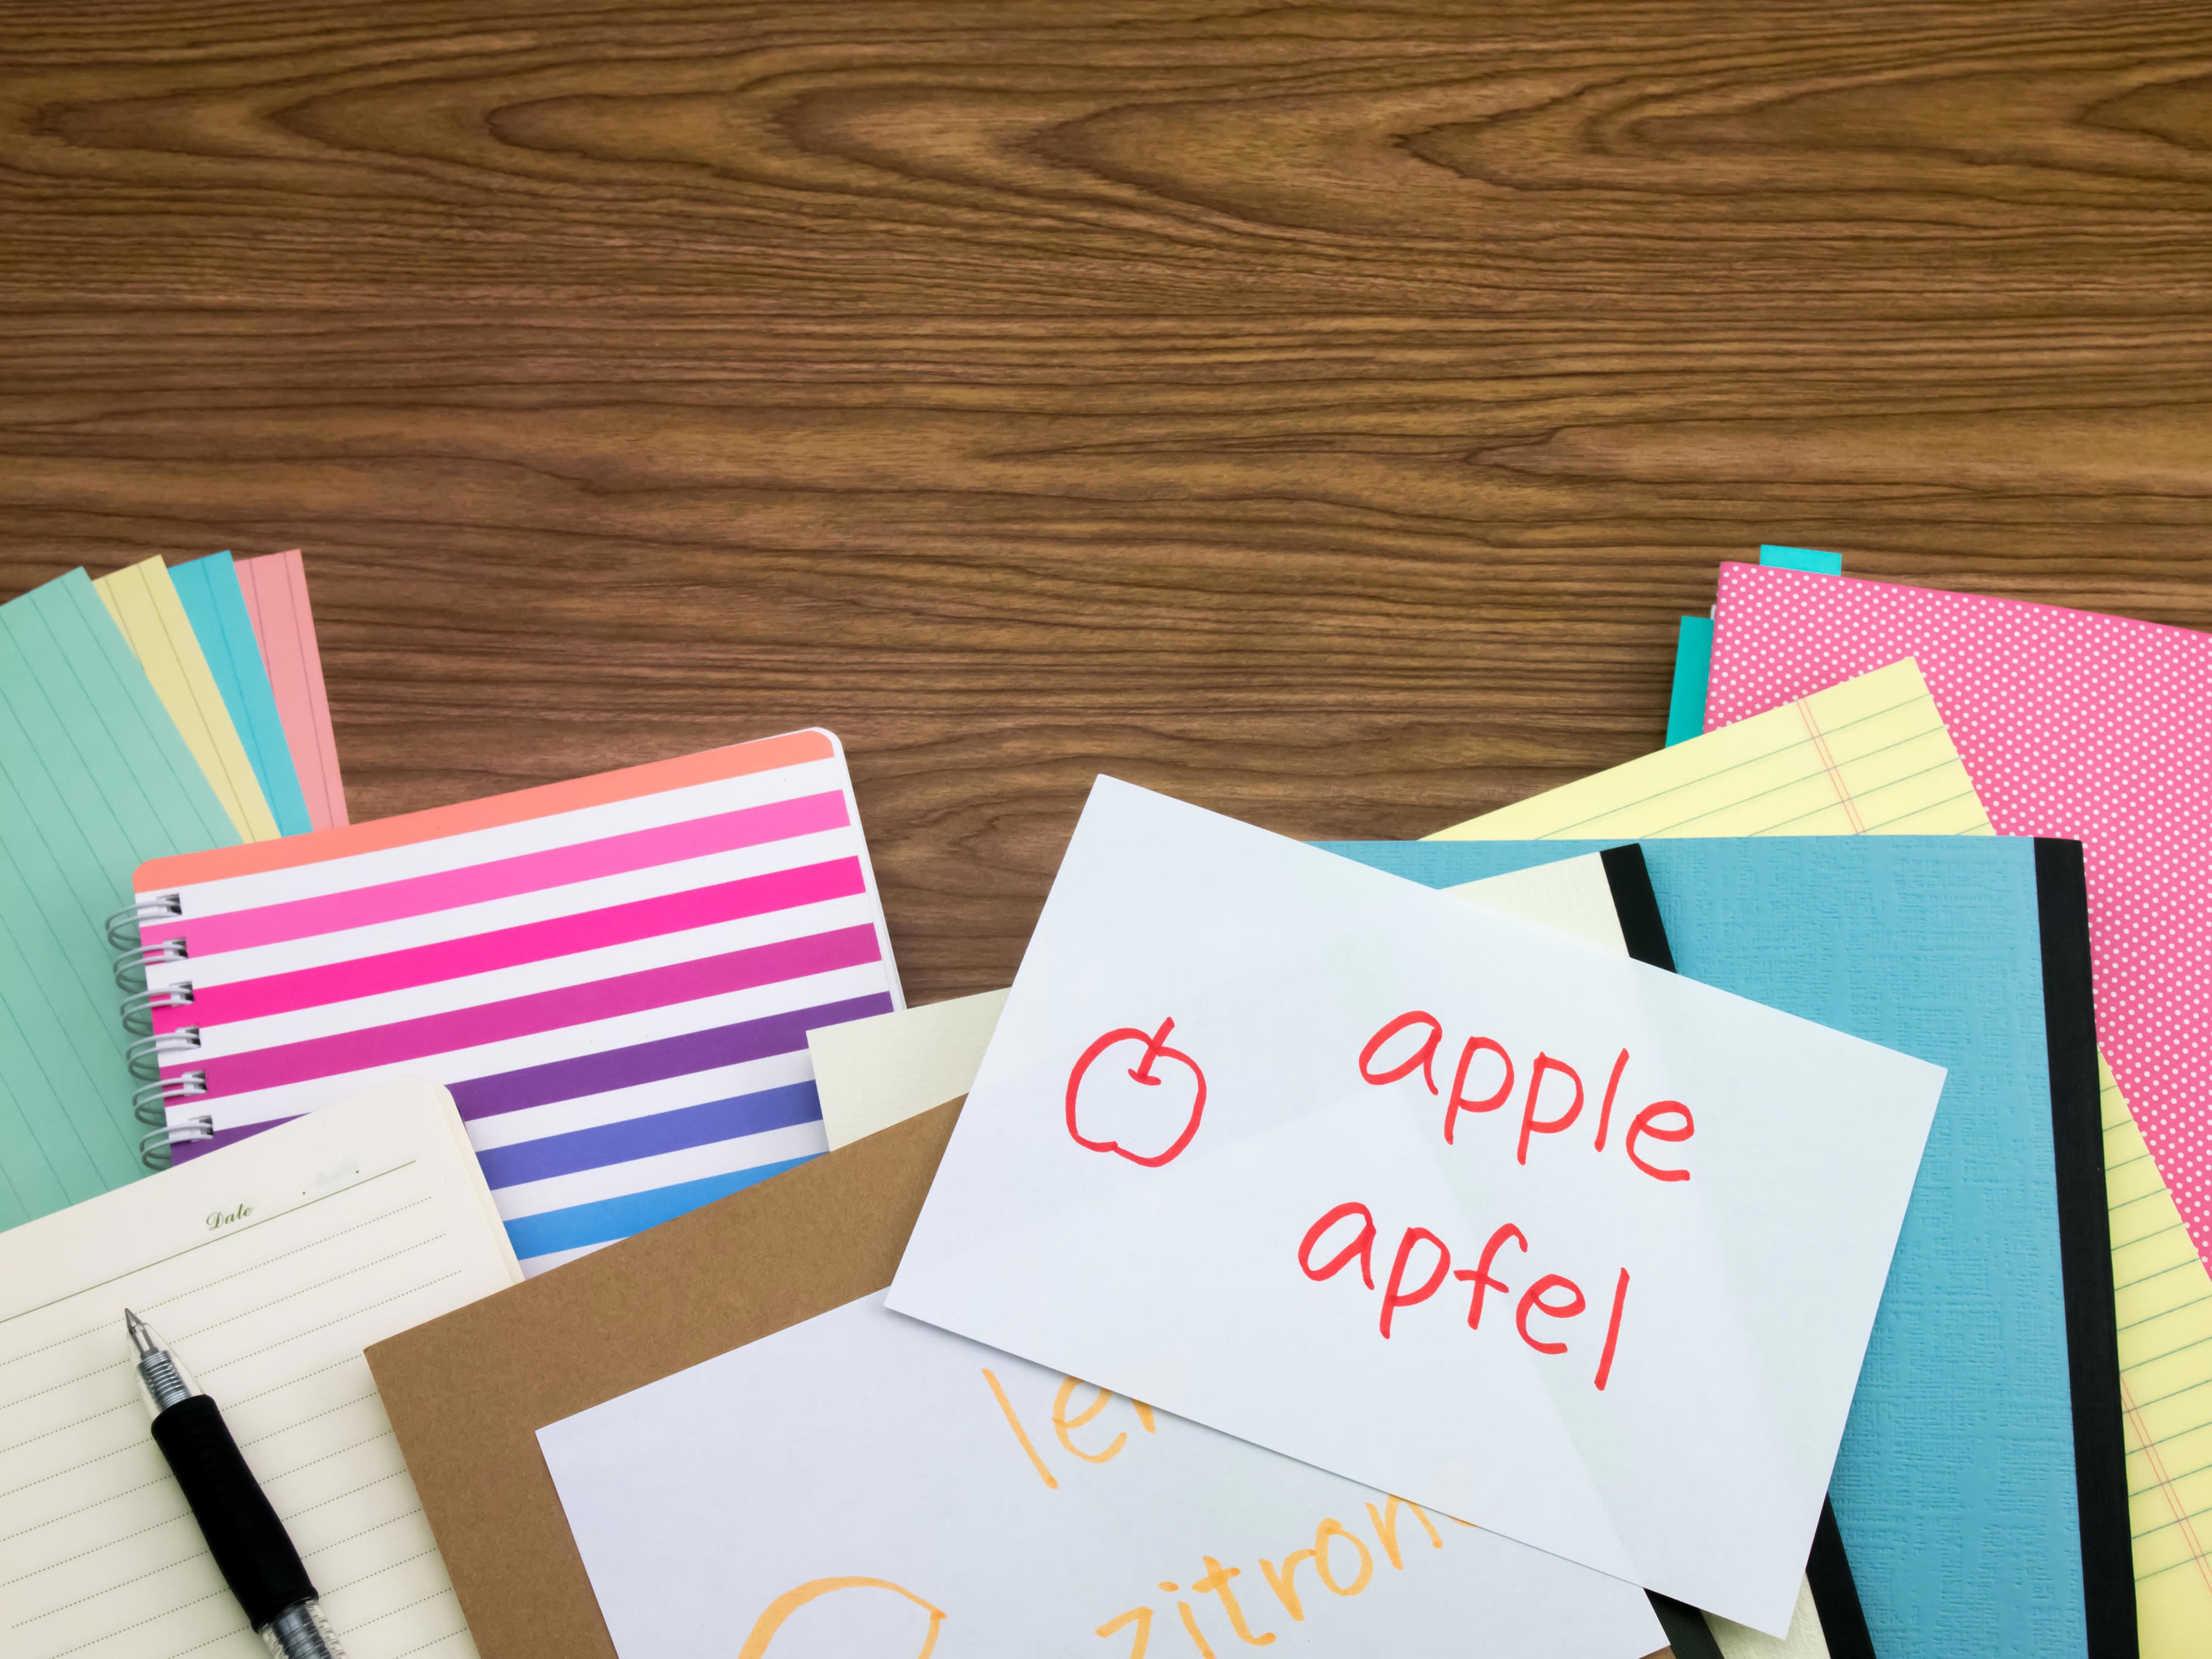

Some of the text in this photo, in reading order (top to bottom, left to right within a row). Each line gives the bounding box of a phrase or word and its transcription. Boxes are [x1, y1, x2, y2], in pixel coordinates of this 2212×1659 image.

[1359, 1011, 1694, 1182] apple
[206, 1203, 255, 1231] Date
[1298, 1202, 1630, 1390] apfel
[981, 1368, 1156, 1490] le
[1095, 1494, 1478, 1659] zitron
